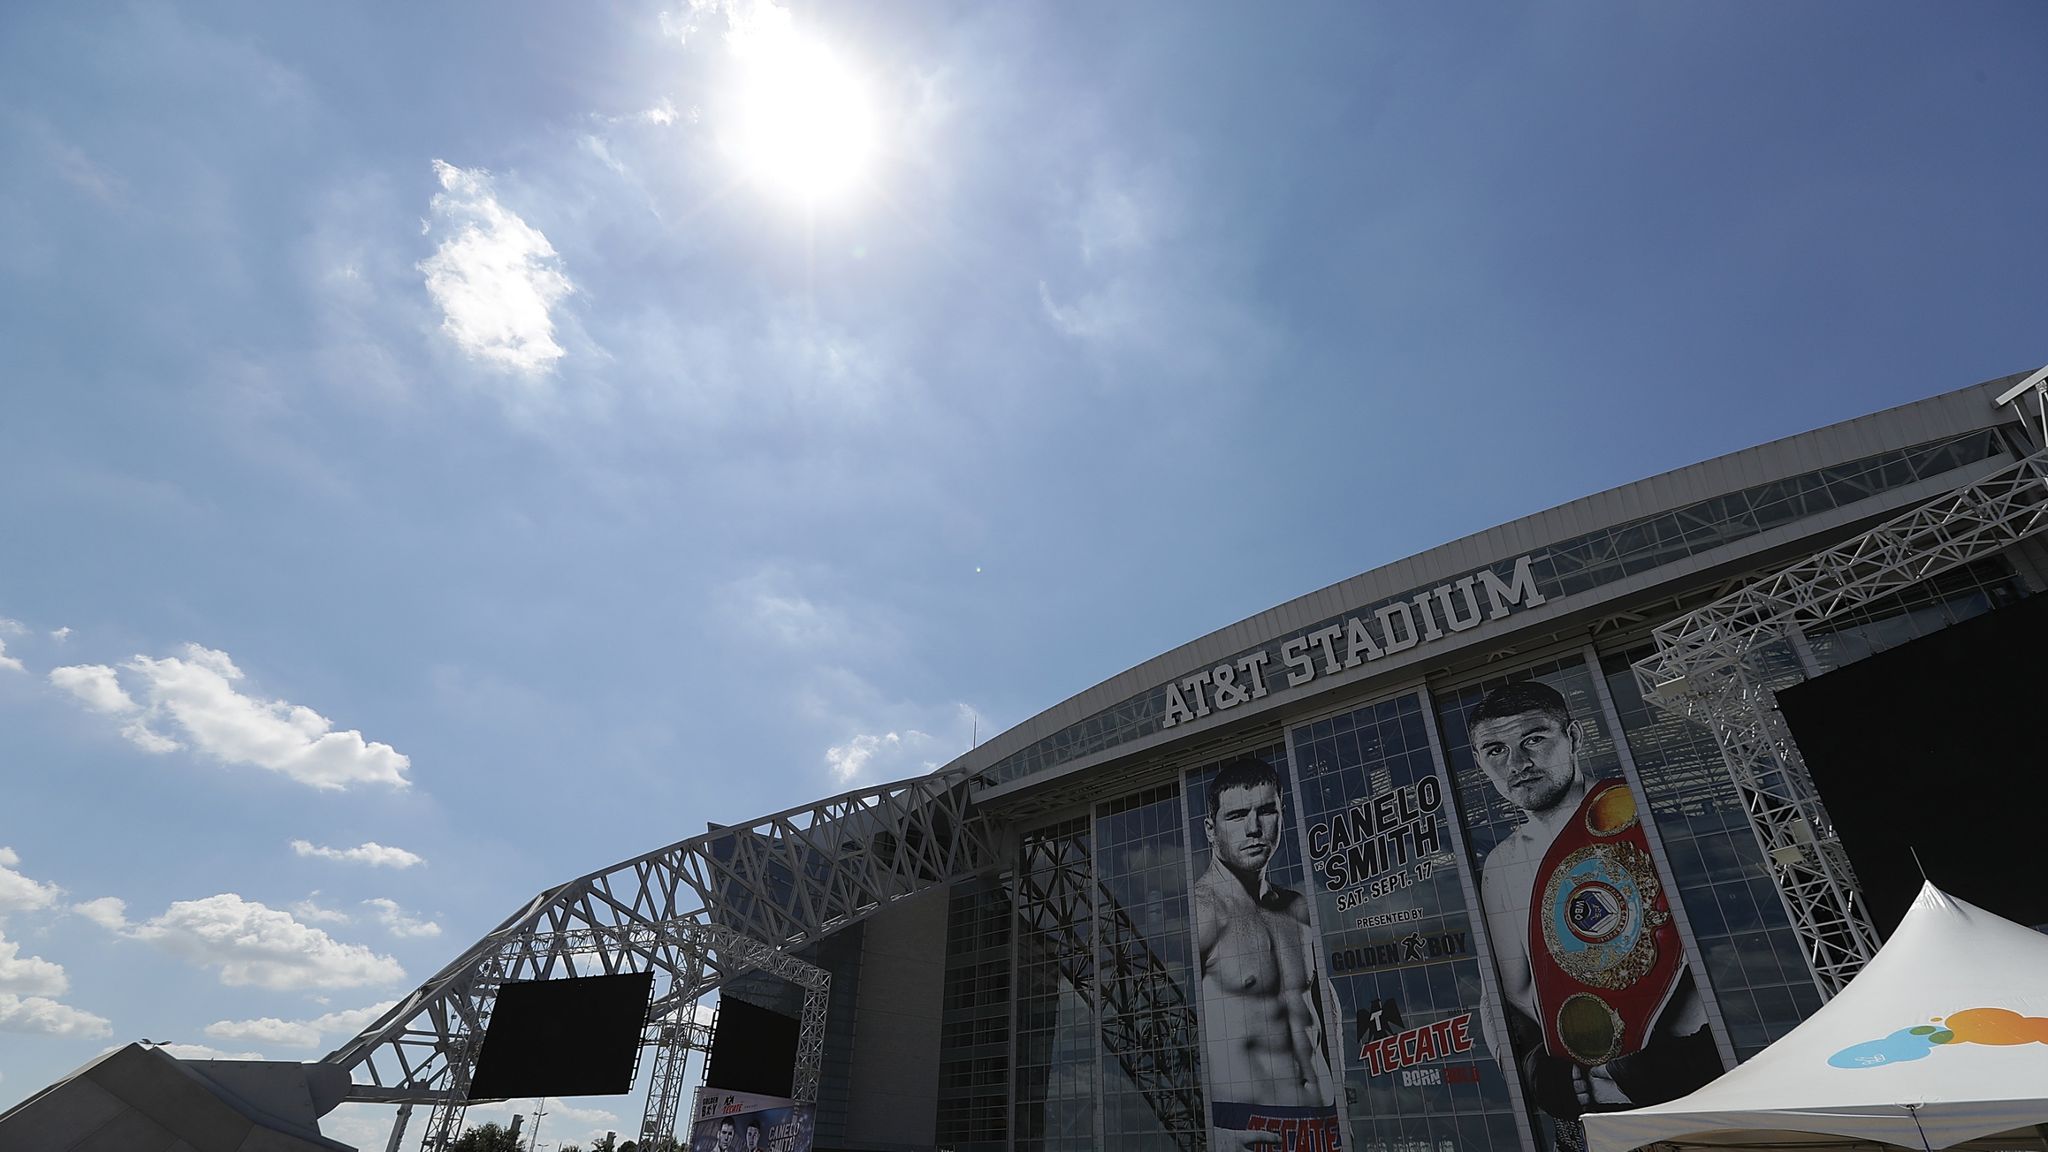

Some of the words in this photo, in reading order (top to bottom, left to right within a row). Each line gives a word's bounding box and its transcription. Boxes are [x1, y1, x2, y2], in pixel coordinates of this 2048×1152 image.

[1163, 650, 1269, 728] AT&T
[1281, 555, 1547, 687] STADIUM
[1308, 775, 1443, 860] CANELO
[1325, 814, 1441, 892] SMITH
[1337, 889, 1369, 913] SAT.
[1371, 870, 1413, 899] SEPT.
[1414, 860, 1434, 881] 17
[1356, 910, 1410, 929] PRESENTED
[1411, 907, 1424, 919] BY
[1574, 900, 1585, 921] WBO
[1331, 942, 1400, 972] GOLDEN
[1427, 932, 1467, 957] BOY
[1359, 1012, 1474, 1077] TECATE
[1402, 1068, 1442, 1087] BORN
[701, 1104, 718, 1118] BY
[768, 1122, 800, 1140] CANELO
